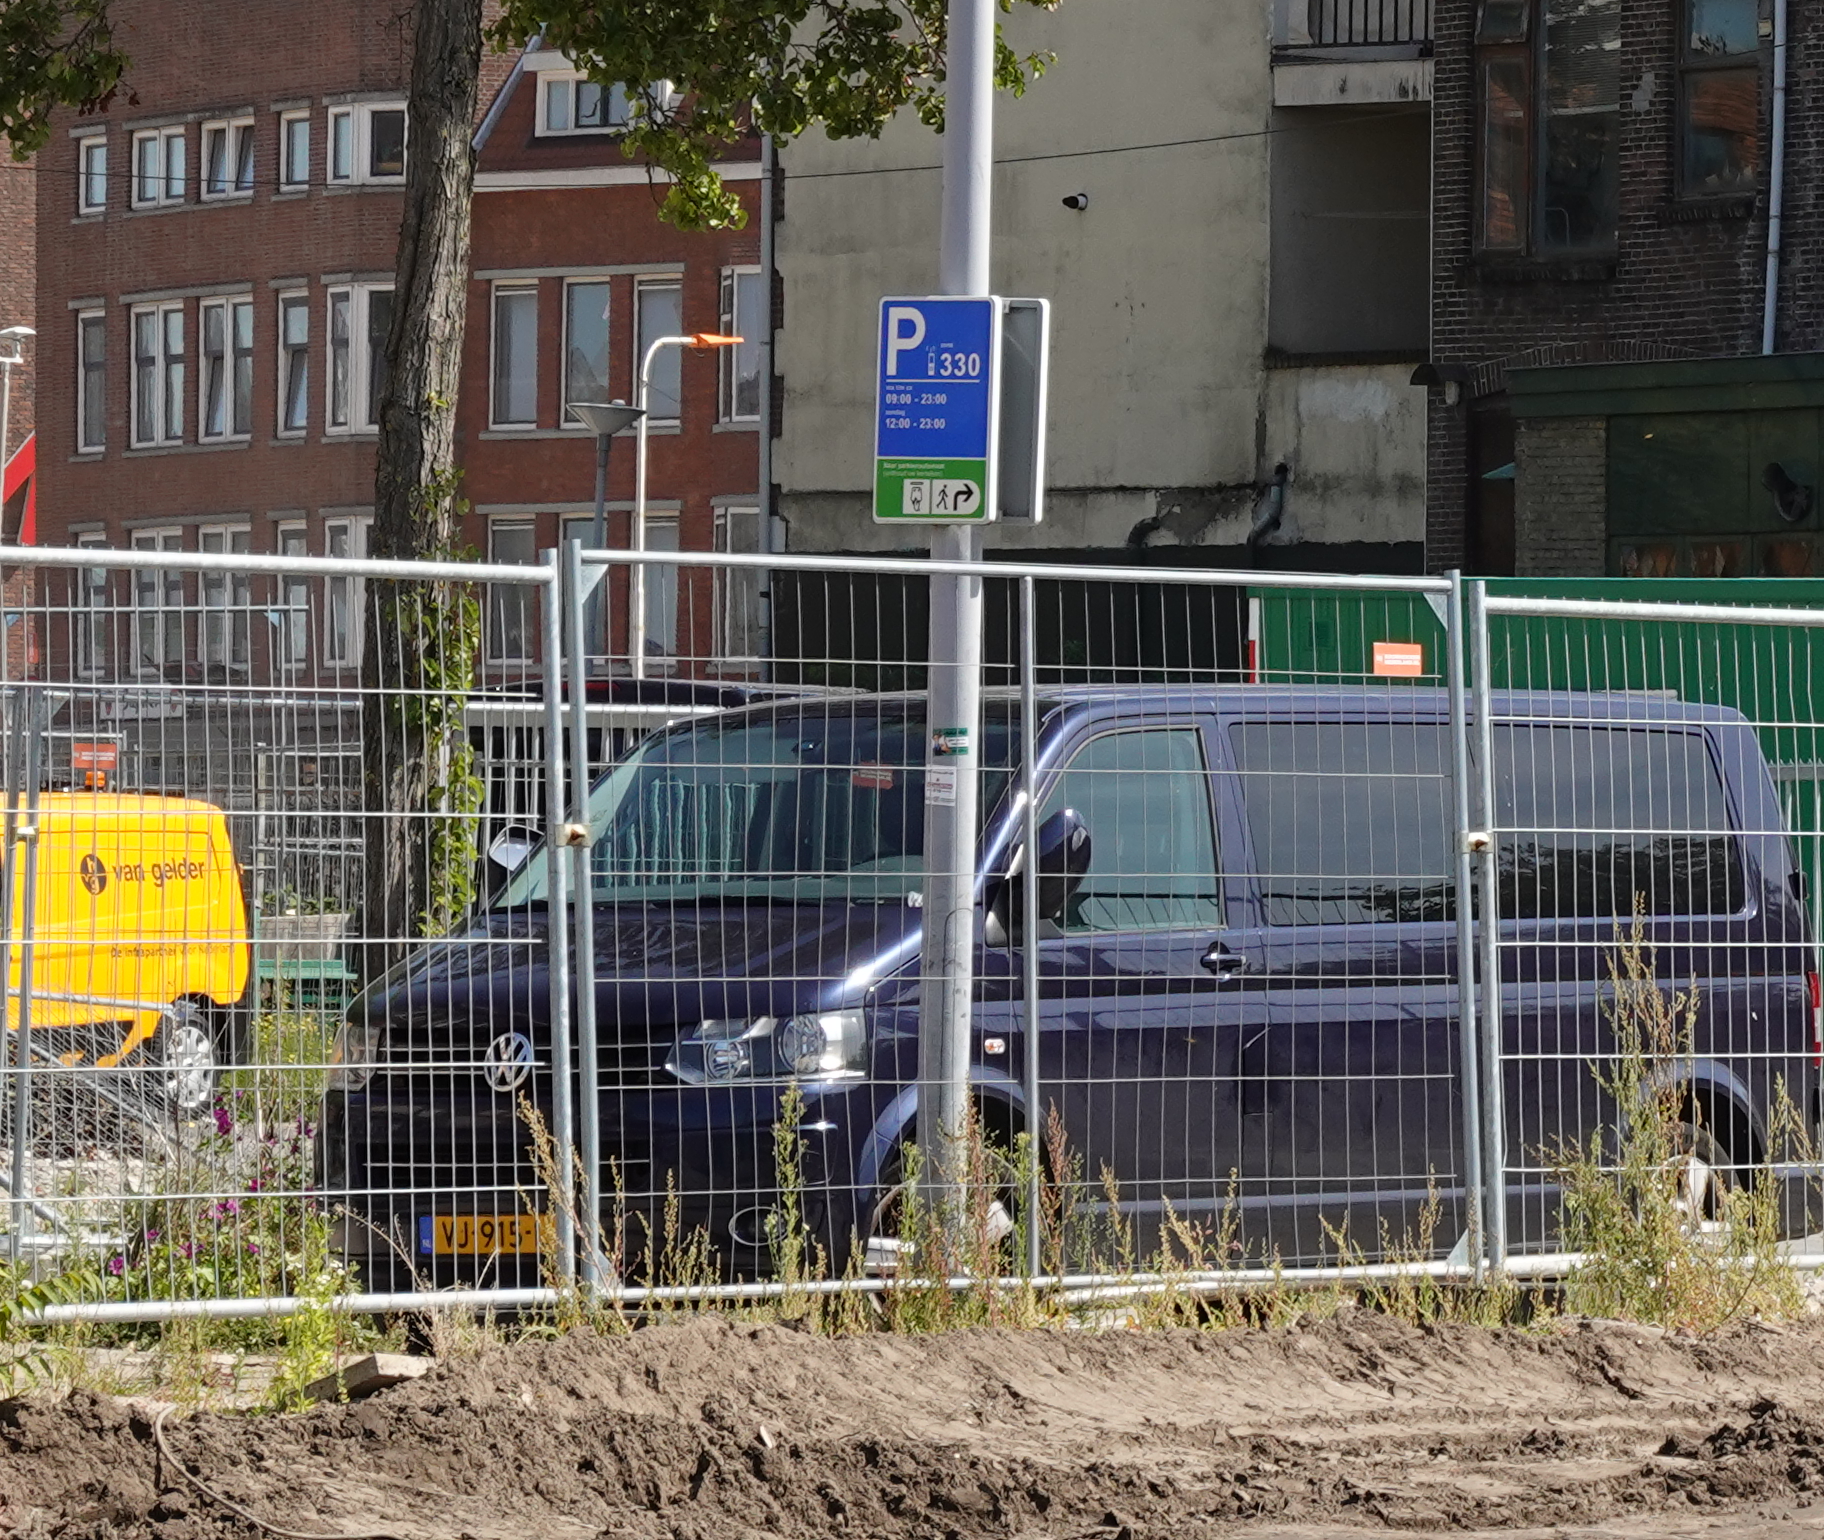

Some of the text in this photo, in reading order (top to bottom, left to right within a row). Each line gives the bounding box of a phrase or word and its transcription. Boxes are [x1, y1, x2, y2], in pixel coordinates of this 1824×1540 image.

[886, 307, 926, 376] P
[939, 353, 980, 376] 330
[885, 394, 912, 404] 09:00
[920, 394, 947, 404] 23:00
[885, 418, 910, 429] 12:00
[919, 418, 946, 429] 23:00
[112, 857, 204, 887] van gelder
[442, 1220, 539, 1249] VJ-915-
